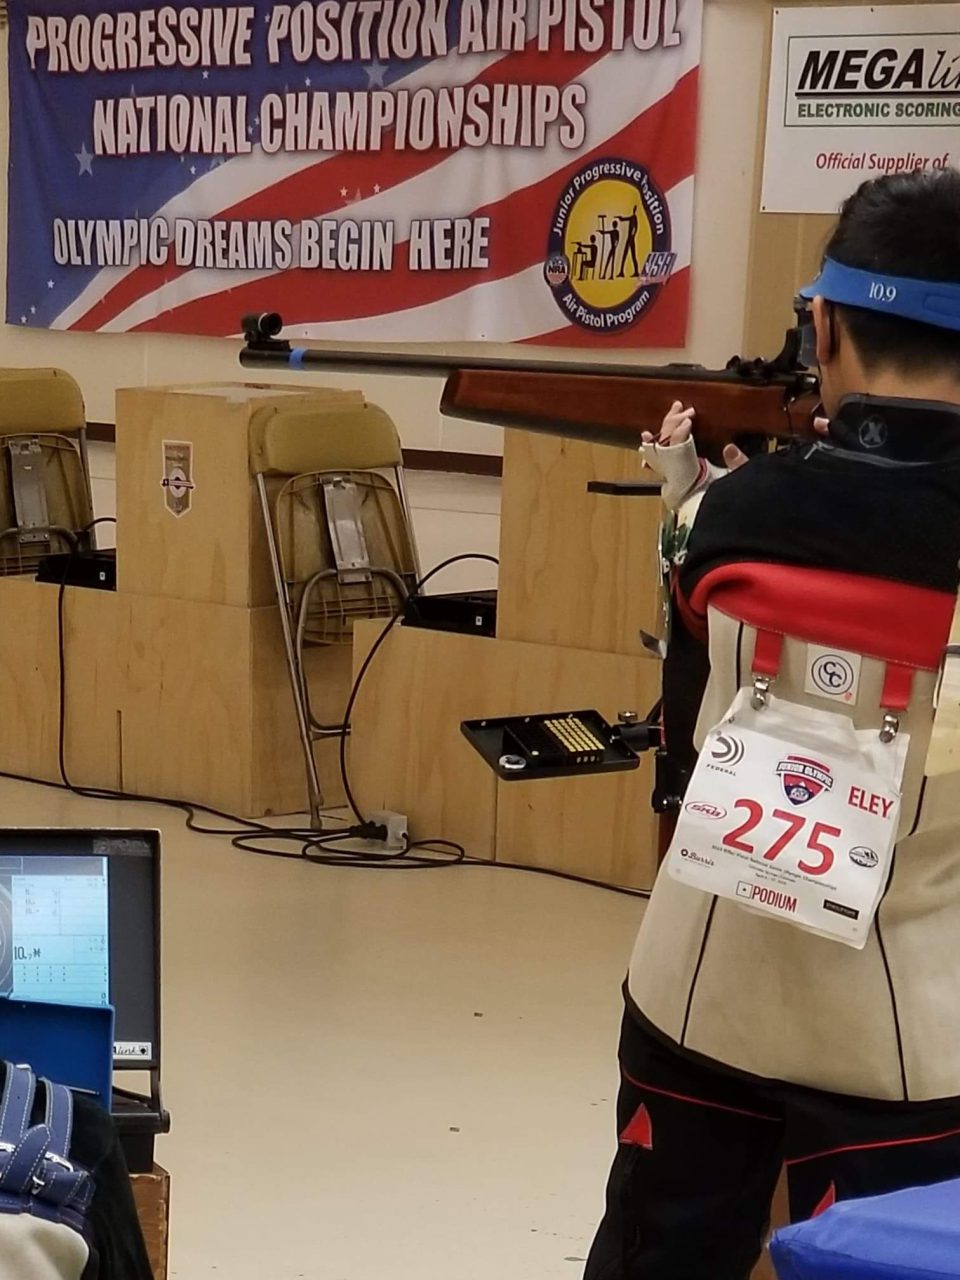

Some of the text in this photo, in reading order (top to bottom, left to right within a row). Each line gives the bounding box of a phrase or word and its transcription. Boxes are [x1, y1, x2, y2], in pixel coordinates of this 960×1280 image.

[26, 0, 681, 72] PROGRESSIVE POSITION AIR PISTOL
[797, 48, 960, 90] MEGAli
[93, 83, 587, 157] NATIONAL CHAMPIONSHIPS
[797, 101, 960, 118] ELECTRONIC SCORING
[816, 151, 949, 174] Official Supplier of
[552, 190, 575, 237] Junior
[573, 162, 641, 190] Progressive
[52, 217, 490, 271] OLYMPIC DREAMS BEGIN HERE
[563, 290, 651, 328] Air Pistol Program
[869, 282, 896, 302] 10.9
[848, 786, 894, 818] ELEY
[722, 798, 842, 876] 275
[751, 885, 798, 913] PODIUM
